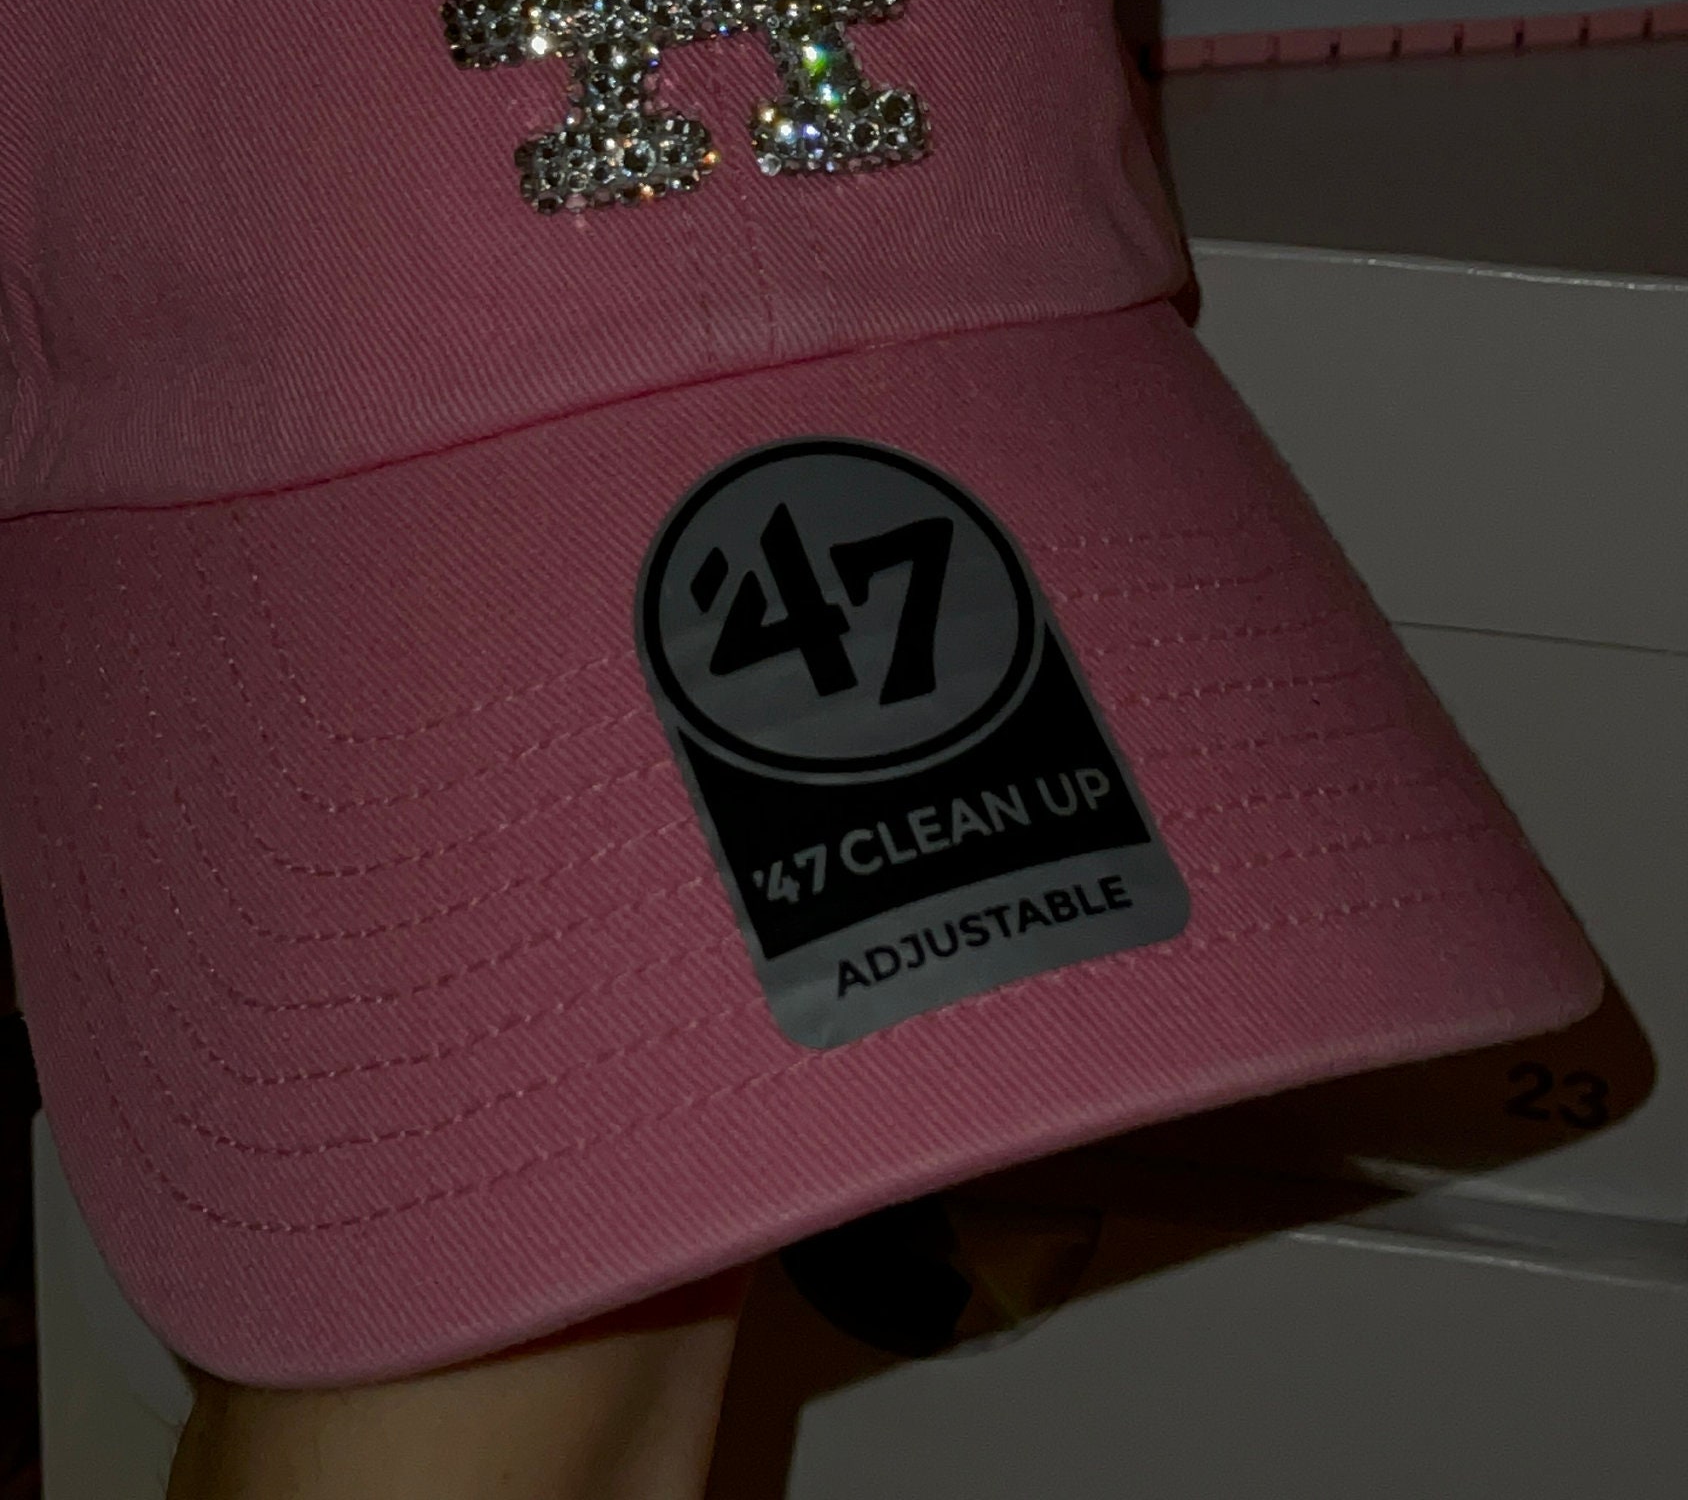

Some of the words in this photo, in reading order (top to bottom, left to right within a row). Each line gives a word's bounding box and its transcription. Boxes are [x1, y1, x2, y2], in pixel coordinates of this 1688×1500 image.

[839, 784, 1031, 876] CLEAN
[1039, 767, 1111, 818] UP
[837, 875, 1133, 998] ADJUSTABLE
[1505, 1062, 1609, 1129] 23
